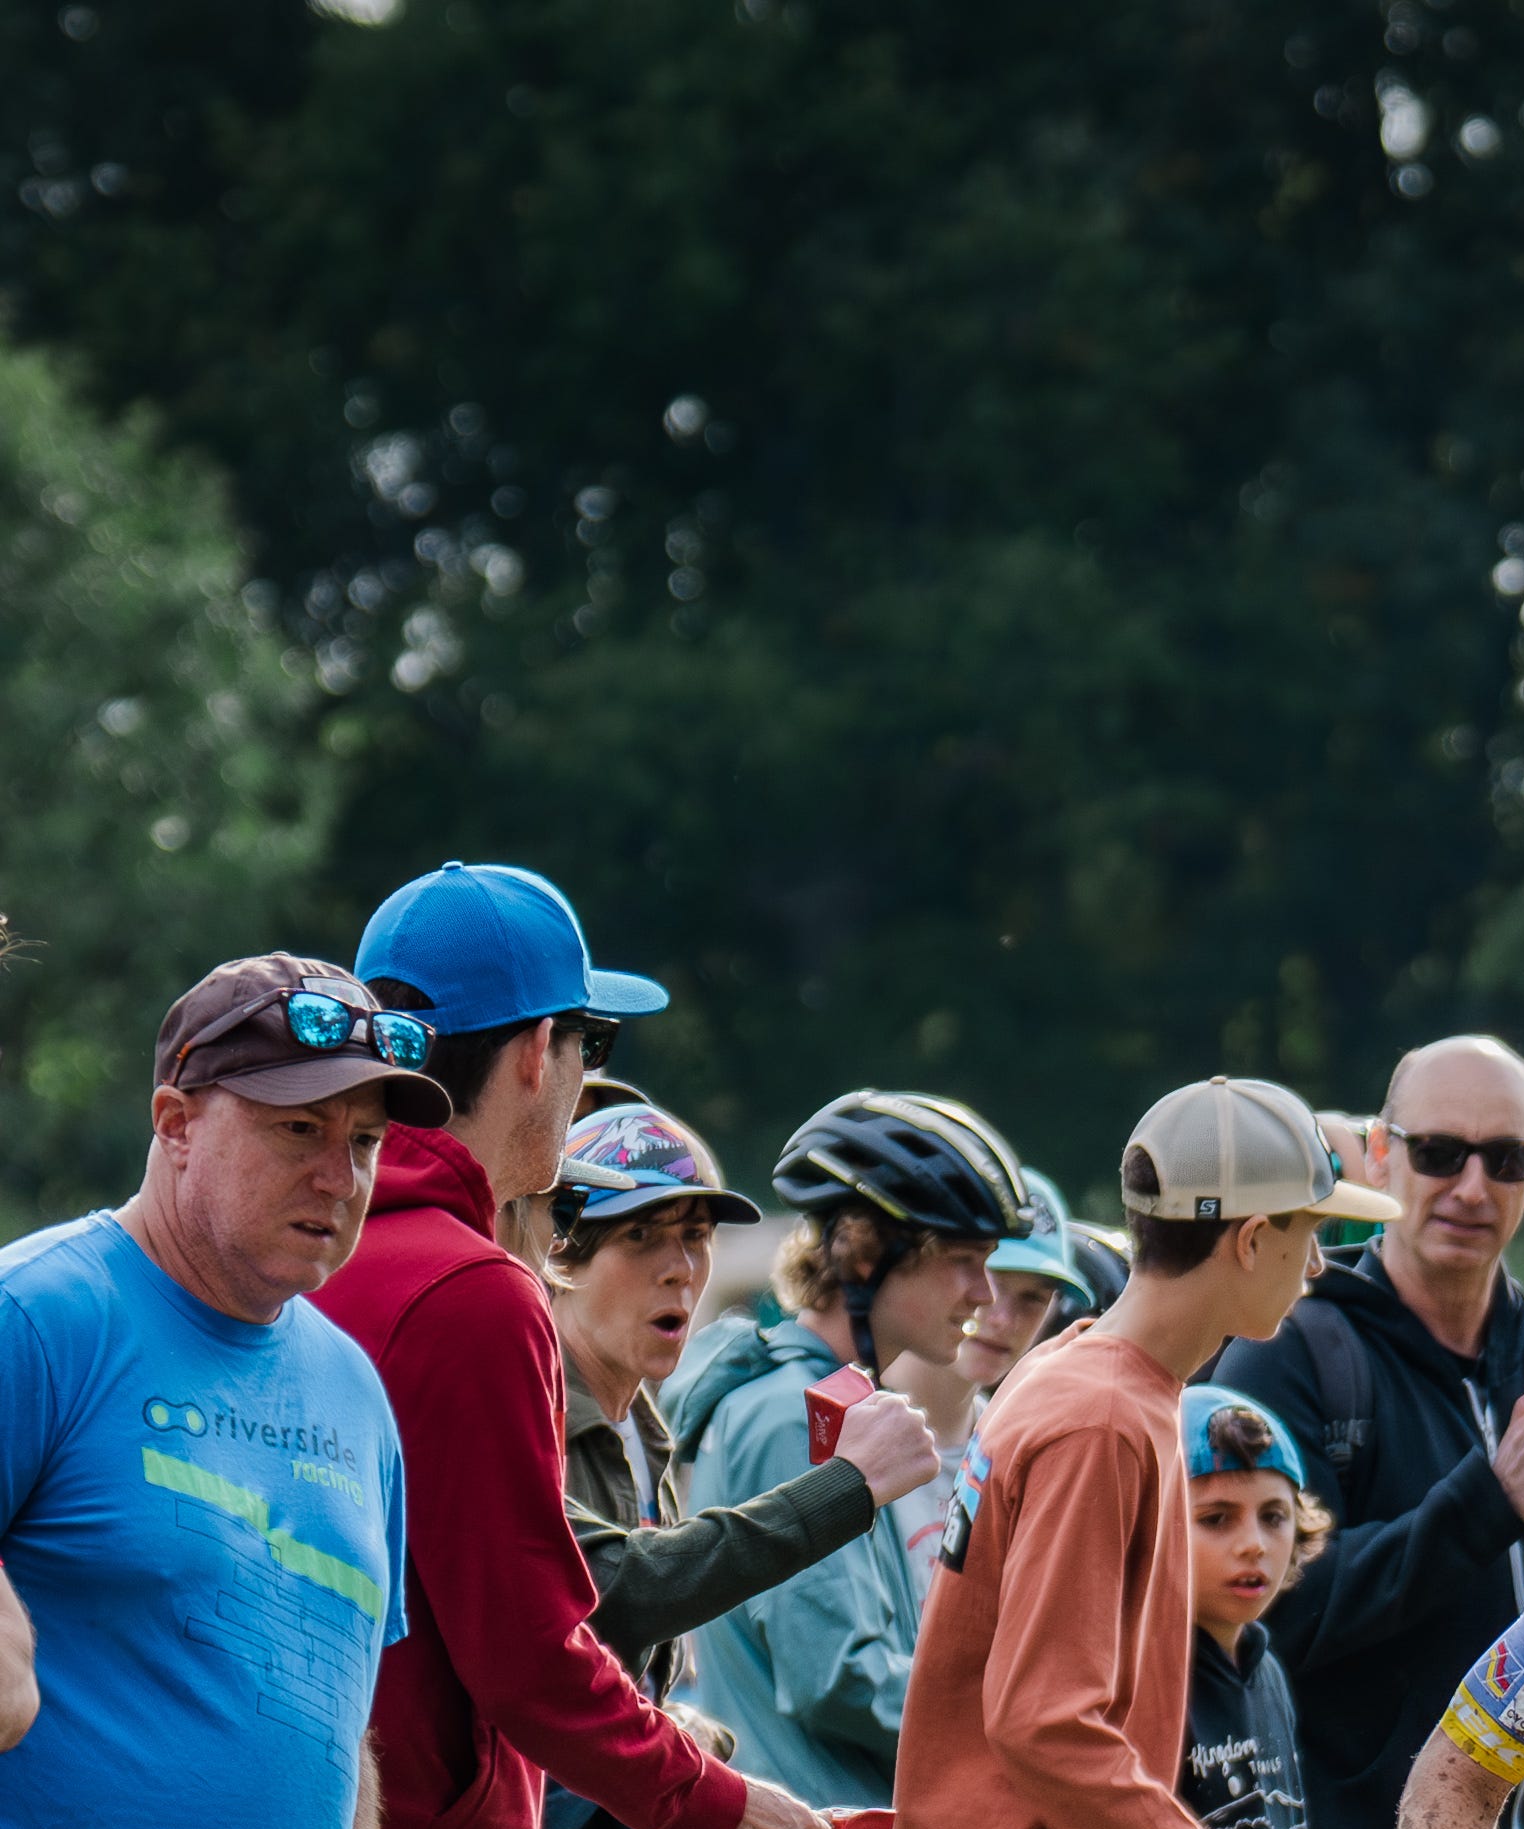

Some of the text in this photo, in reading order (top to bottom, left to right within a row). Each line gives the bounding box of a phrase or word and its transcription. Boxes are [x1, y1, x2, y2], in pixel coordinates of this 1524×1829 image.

[213, 1407, 357, 1472] riverside
[291, 1459, 365, 1506] racing
[1189, 1734, 1259, 1779] Kingdom
